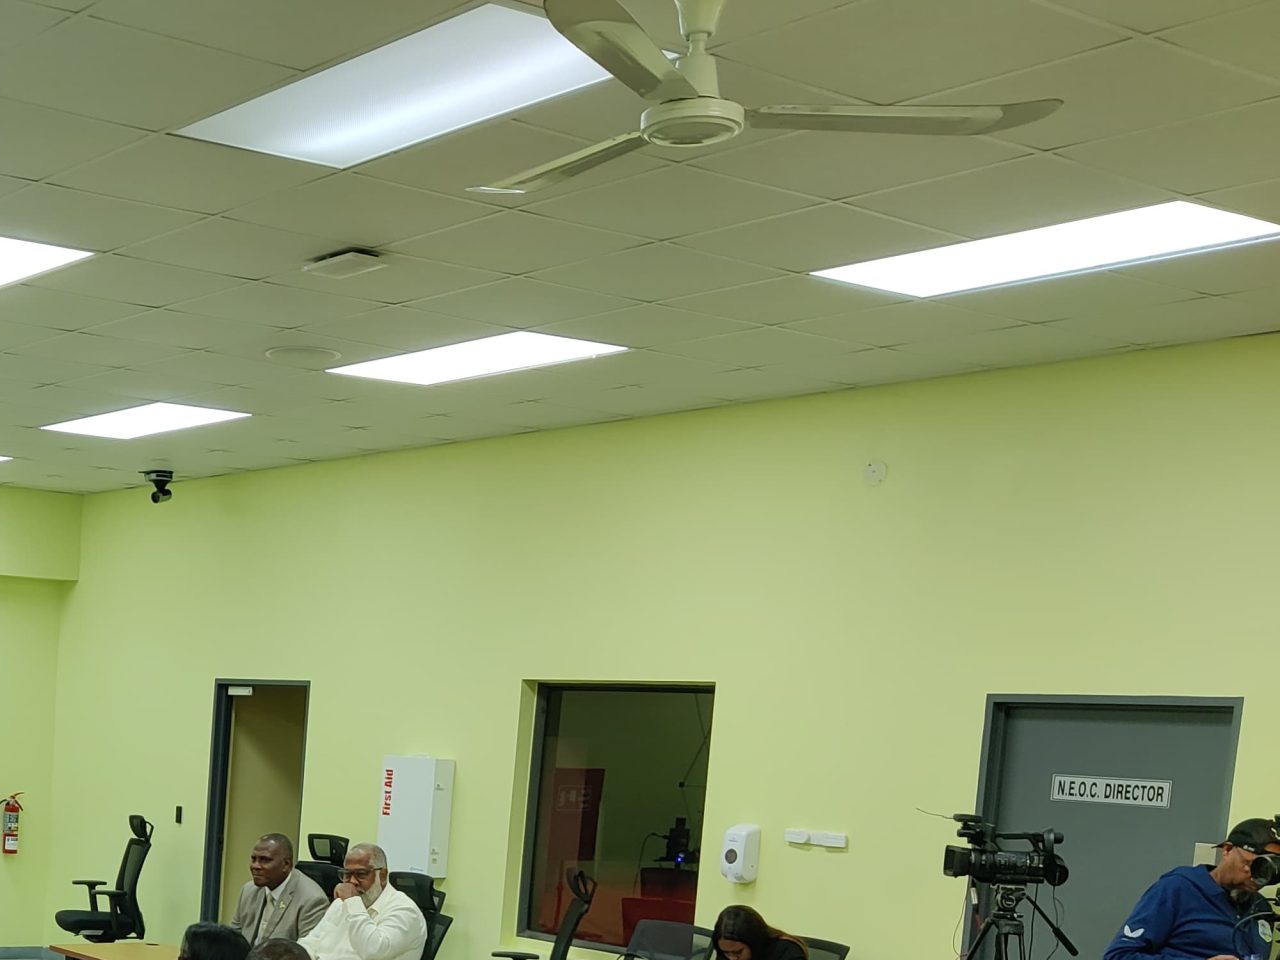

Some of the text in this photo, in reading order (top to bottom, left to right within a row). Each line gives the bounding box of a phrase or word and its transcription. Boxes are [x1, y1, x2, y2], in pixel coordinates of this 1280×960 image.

[382, 769, 394, 816] First Aid
[1058, 780, 1164, 802] N.E.O.C. DIRECTOR
